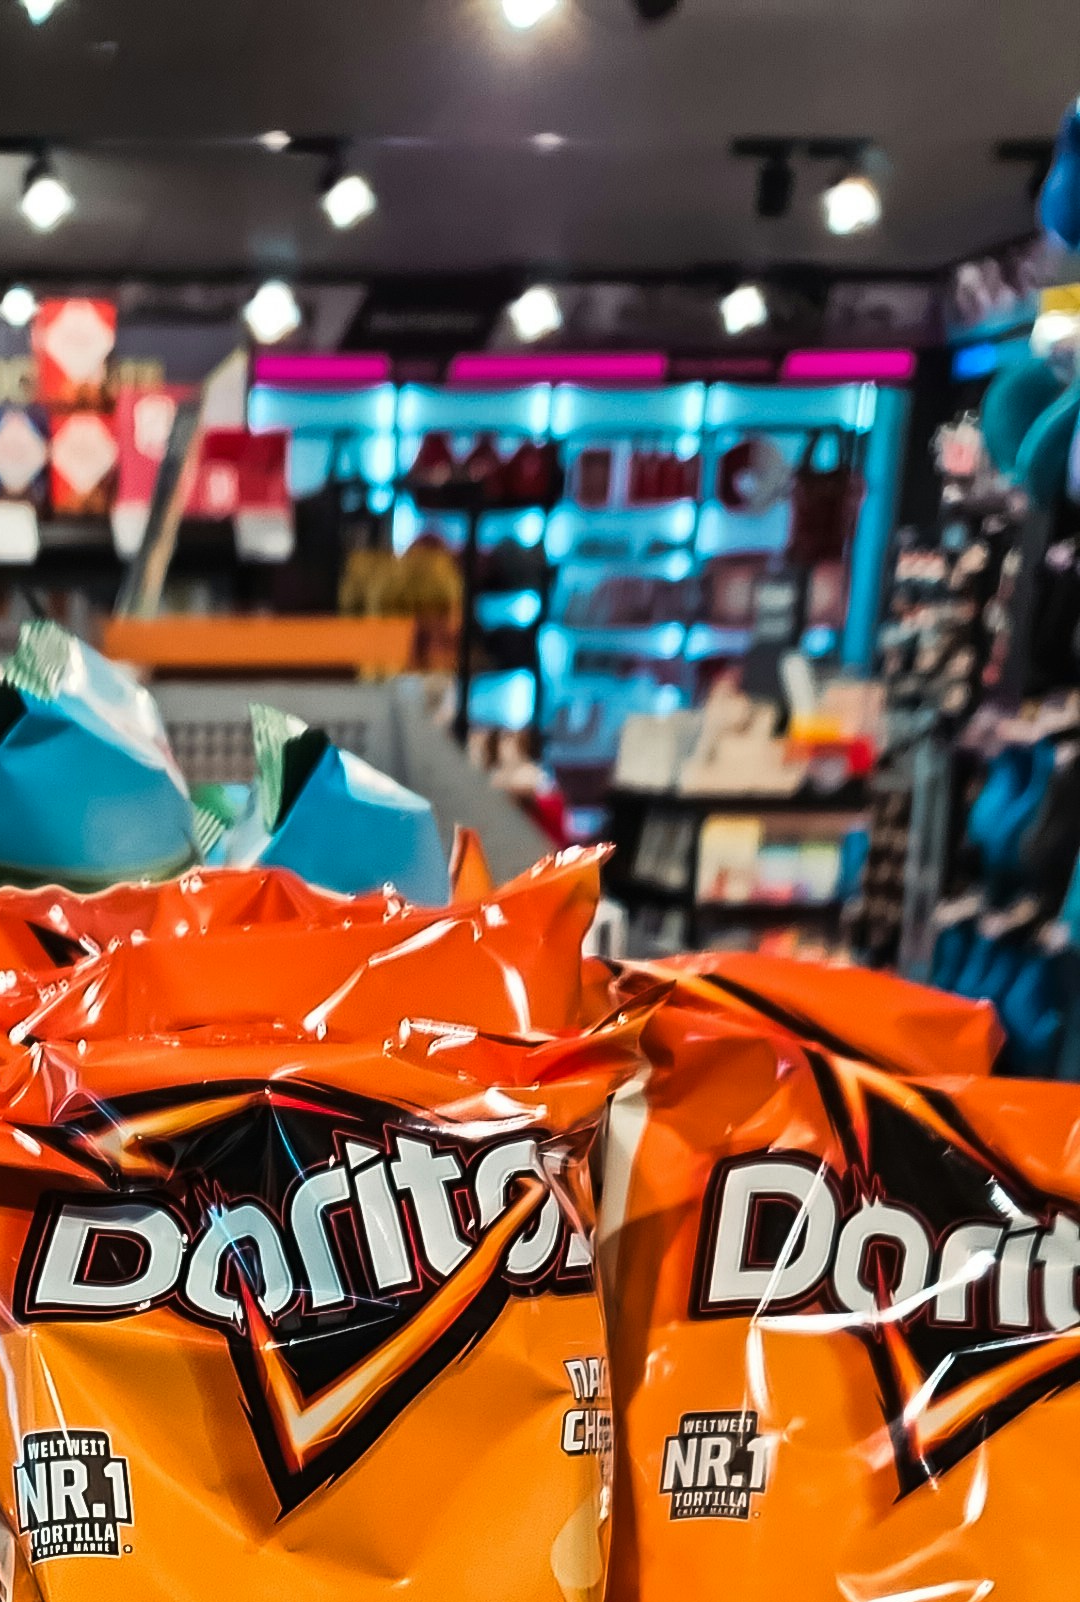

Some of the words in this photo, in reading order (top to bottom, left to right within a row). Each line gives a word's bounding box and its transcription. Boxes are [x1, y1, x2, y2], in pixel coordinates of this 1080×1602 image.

[33, 1136, 592, 1319] Dorito
[708, 1162, 1080, 1332] Dorit
[683, 1418, 753, 1434] WELTWEIT
[27, 1439, 106, 1460] WELTWEIT
[663, 1436, 767, 1490] NR.1
[16, 1459, 128, 1529] NR.1
[674, 1490, 747, 1508] TORTILLA
[31, 1522, 116, 1547] TORTILLA
